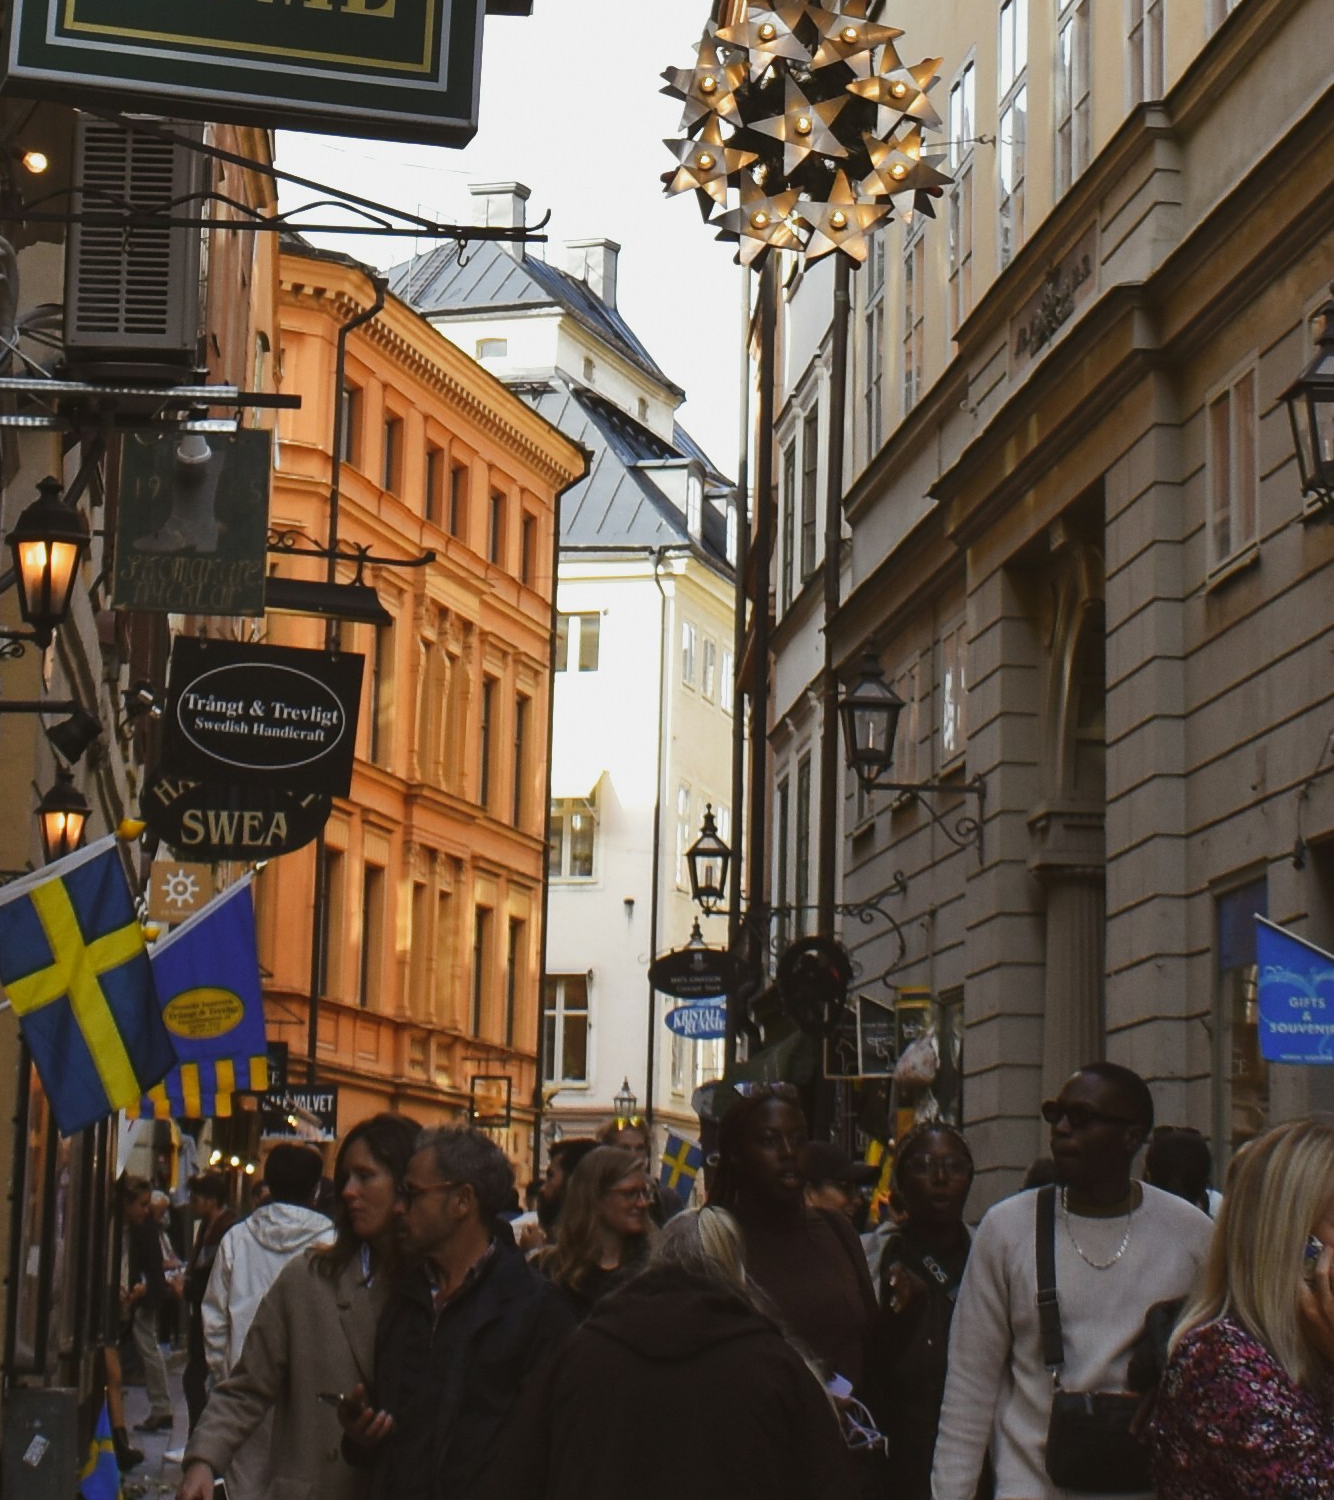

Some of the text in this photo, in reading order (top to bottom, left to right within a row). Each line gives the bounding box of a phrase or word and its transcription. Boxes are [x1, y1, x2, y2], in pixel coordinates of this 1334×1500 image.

[185, 693, 339, 727] Trångt & Trevligt
[194, 717, 325, 742] Swedish Handicraft
[179, 809, 289, 847] SWEA
[1288, 996, 1326, 1009] GIFTS
[1301, 1010, 1313, 1022] &
[922, 1255, 949, 1284] EOS
